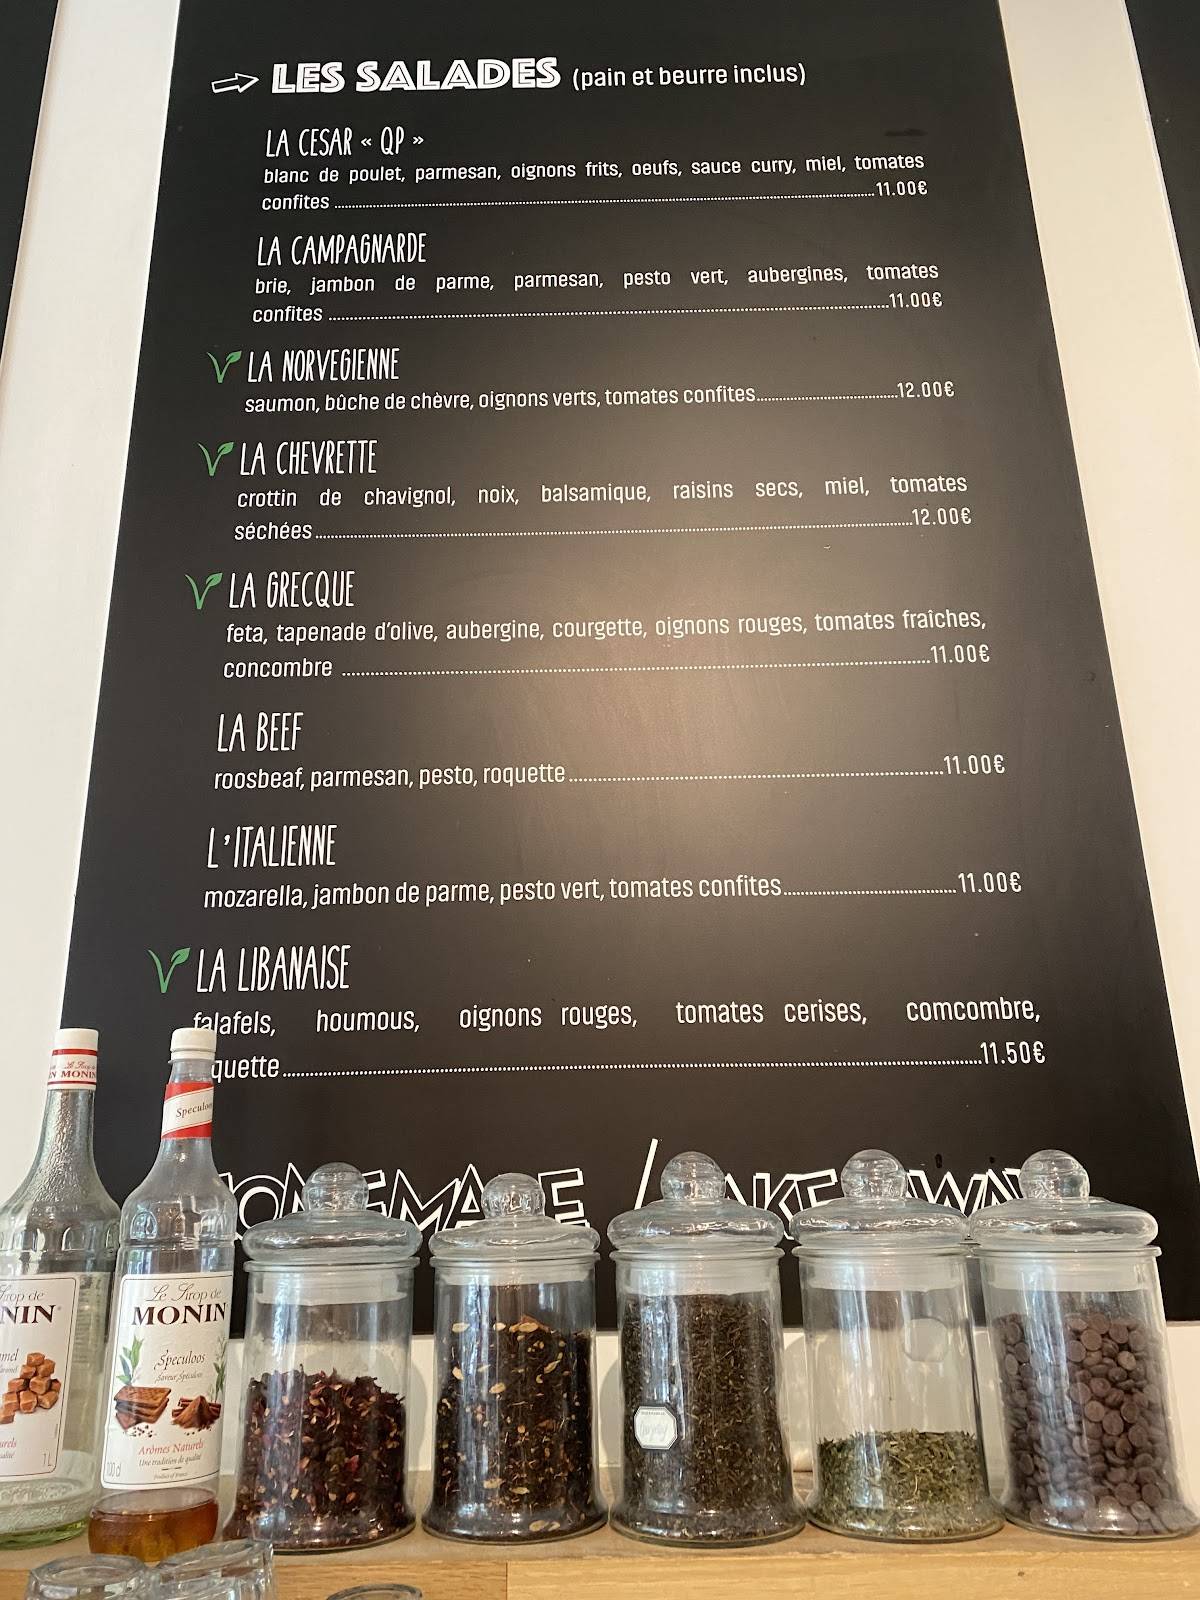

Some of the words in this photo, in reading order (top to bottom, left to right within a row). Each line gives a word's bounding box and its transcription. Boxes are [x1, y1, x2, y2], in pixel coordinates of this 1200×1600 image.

[271, 61, 346, 94] LES
[355, 56, 562, 93] SALADES
[572, 67, 626, 92] (pain
[632, 67, 655, 87] et
[658, 66, 728, 86] beurre
[733, 62, 806, 86] inclus)
[265, 128, 290, 158] LA
[298, 126, 353, 157] CESAR
[360, 137, 372, 147] «
[380, 125, 405, 156] QP
[412, 135, 425, 145] »
[263, 168, 310, 184] blanc
[318, 166, 340, 183] de
[348, 165, 406, 185] poulet,
[415, 166, 502, 184] parmesan,
[510, 162, 577, 181] oignons
[584, 161, 623, 179] frits,
[631, 159, 683, 177] oeufs,
[690, 160, 742, 175] sauce
[750, 159, 797, 175] curry,
[805, 155, 847, 173] miel,
[853, 154, 925, 171] tomates
[261, 193, 330, 211] confites
[875, 180, 928, 197] 11.00€
[257, 235, 282, 267] LA
[290, 232, 428, 266] CAMPAGNARDE
[255, 277, 292, 296] brie,
[309, 275, 375, 296] jambon
[394, 274, 416, 291] de
[435, 275, 495, 294] parme,
[514, 273, 604, 292] parmesan,
[623, 269, 671, 290] pesto
[690, 268, 729, 286] vert,
[747, 265, 848, 285] aubergines,
[865, 263, 939, 281] tomates
[252, 305, 323, 323] confites
[888, 291, 943, 309] 11.00€
[247, 350, 273, 383] LA
[281, 347, 401, 383] NORVEGIENNE
[244, 397, 321, 414] saumon,
[324, 393, 380, 412] bûche
[384, 392, 406, 410] de
[410, 391, 475, 411] chèvre,
[478, 390, 549, 411] oignons
[552, 389, 601, 408] verts,
[604, 387, 679, 406] tomates
[683, 385, 756, 404] confites
[896, 380, 955, 399] 12.00€
[239, 441, 266, 476] LA
[276, 439, 378, 476] CHEVRETTE
[237, 488, 297, 508] crottin
[319, 487, 342, 507] de
[363, 485, 456, 508] chavignol,
[478, 484, 520, 506] noix,
[541, 482, 651, 505] balsamique,
[673, 480, 734, 500] raisins
[755, 481, 803, 499] secs,
[824, 476, 870, 497] miel,
[889, 475, 968, 494] tomates
[234, 521, 313, 541] séchées
[911, 506, 972, 526] 12.00€
[228, 571, 257, 609] LA
[266, 570, 356, 609] GRECQUE
[226, 623, 268, 646] feta,
[275, 621, 367, 646] tapenade
[374, 620, 438, 643] d’olive,
[446, 619, 545, 642] aubergine,
[552, 618, 647, 641] courgette,
[655, 616, 730, 639] oignons
[738, 616, 808, 636] rouges,
[814, 612, 895, 632] tomates
[901, 608, 986, 630] fraîches,
[223, 657, 333, 679] concombre
[930, 643, 991, 664] 11.00€
[217, 712, 246, 753] LA
[256, 711, 304, 752] BEEF
[214, 766, 305, 791] roosbeaf,
[310, 768, 414, 793] parmesan,
[419, 765, 478, 790] pesto,
[483, 763, 566, 788] roquette
[943, 753, 1006, 775] 11.00€
[207, 824, 338, 869] L’ITALIENNE
[203, 884, 308, 909] mozarella,
[310, 882, 390, 910] jambon
[395, 881, 420, 904] de
[425, 883, 495, 908] parme,
[500, 879, 556, 906] pesto
[560, 878, 605, 902] vert,
[608, 877, 694, 899] tomates
[698, 874, 782, 898] confites
[957, 871, 1022, 894] 11.00€
[196, 947, 227, 993] LA
[237, 944, 352, 992] LIBANAISE
[316, 1009, 420, 1033] houmous,
[459, 1004, 542, 1032] oignons
[561, 1004, 638, 1030] rouges,
[675, 1000, 764, 1024] tomates
[784, 998, 867, 1026] cerises,
[905, 996, 1041, 1023] comcombre,
[210, 1055, 280, 1084] quette
[979, 1040, 1046, 1065] 11.50€
[145, 1284, 169, 1301] Le
[171, 1282, 208, 1304] Sirop
[0, 1304, 56, 1324] NIN
[131, 1302, 226, 1325] MONIN
[153, 1349, 205, 1370] Speculoos
[173, 1439, 204, 1453] Naturels
